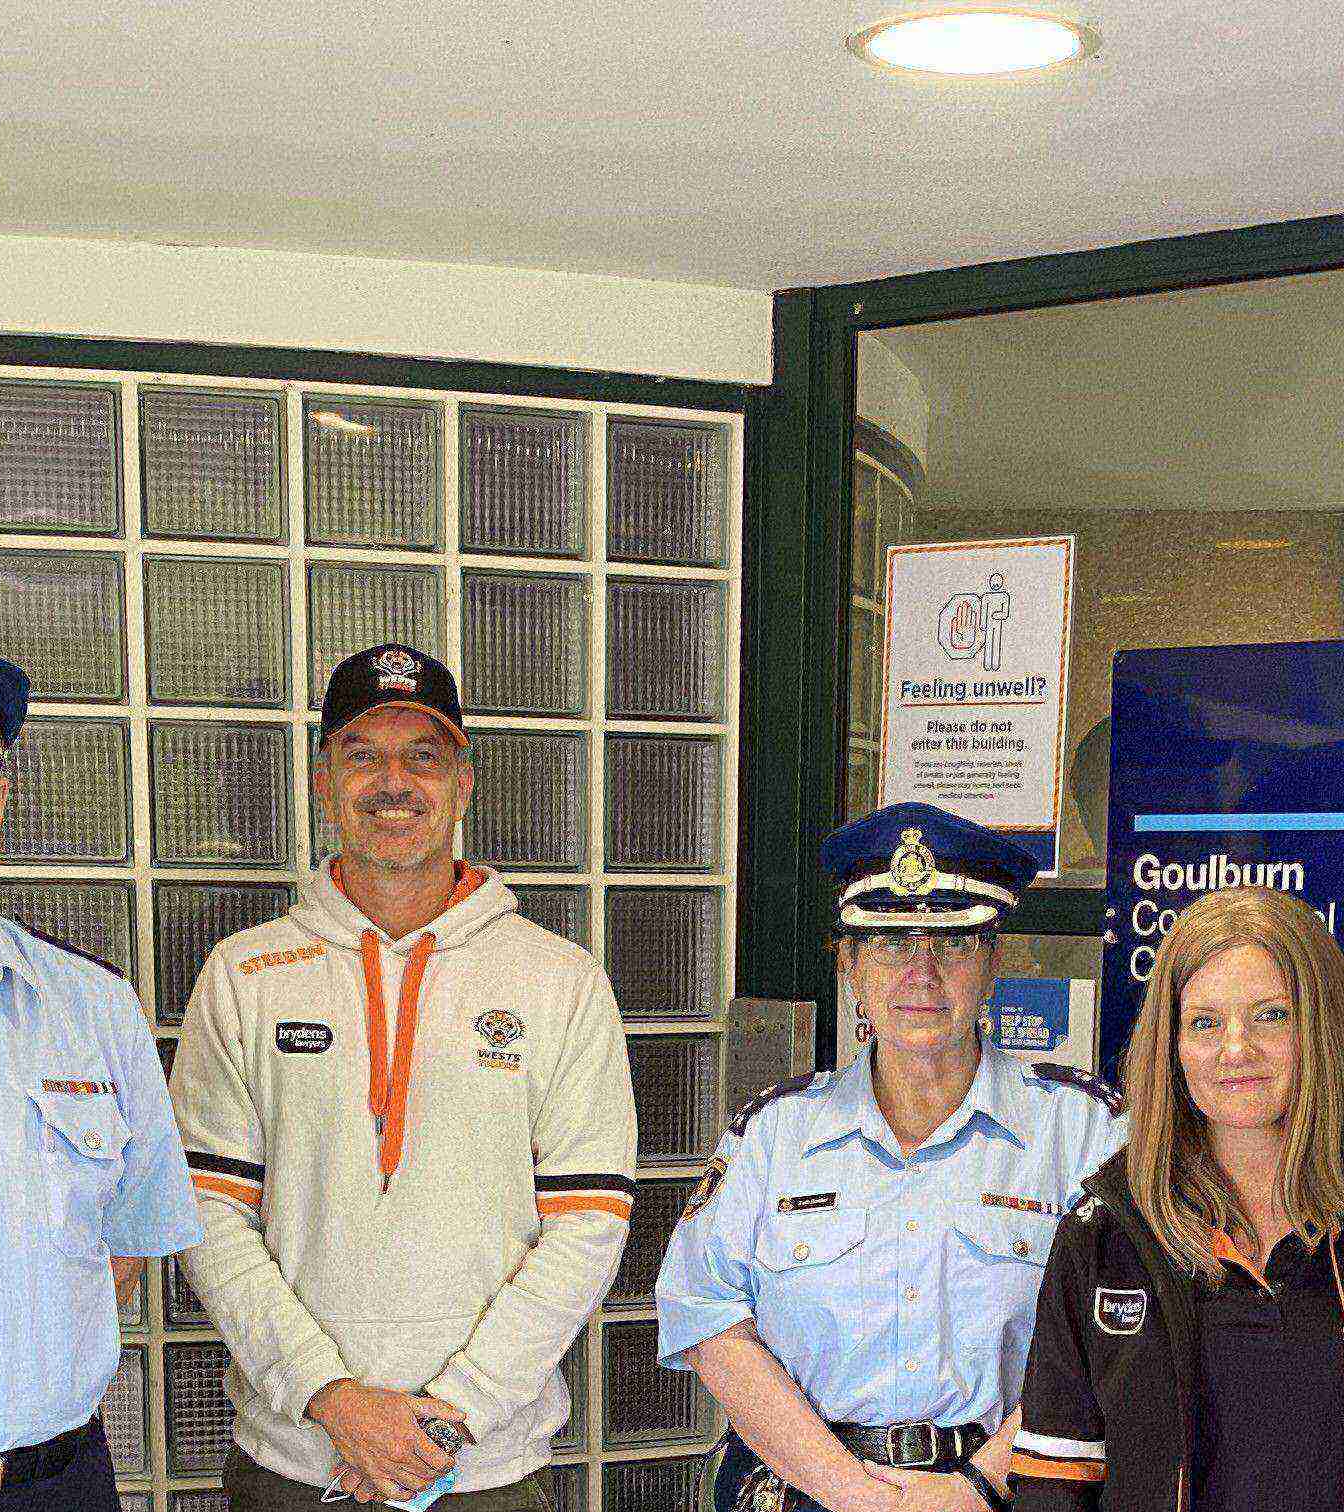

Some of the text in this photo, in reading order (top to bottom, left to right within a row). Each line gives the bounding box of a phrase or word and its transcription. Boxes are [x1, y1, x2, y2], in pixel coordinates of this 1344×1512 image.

[901, 677, 1046, 700] Feeling unwell?
[927, 720, 1012, 733] Please do not
[911, 737, 1029, 752] enter this building.
[1134, 853, 1304, 890] Goulburn
[279, 1027, 327, 1041] brydens
[478, 1049, 522, 1062] WESTS
